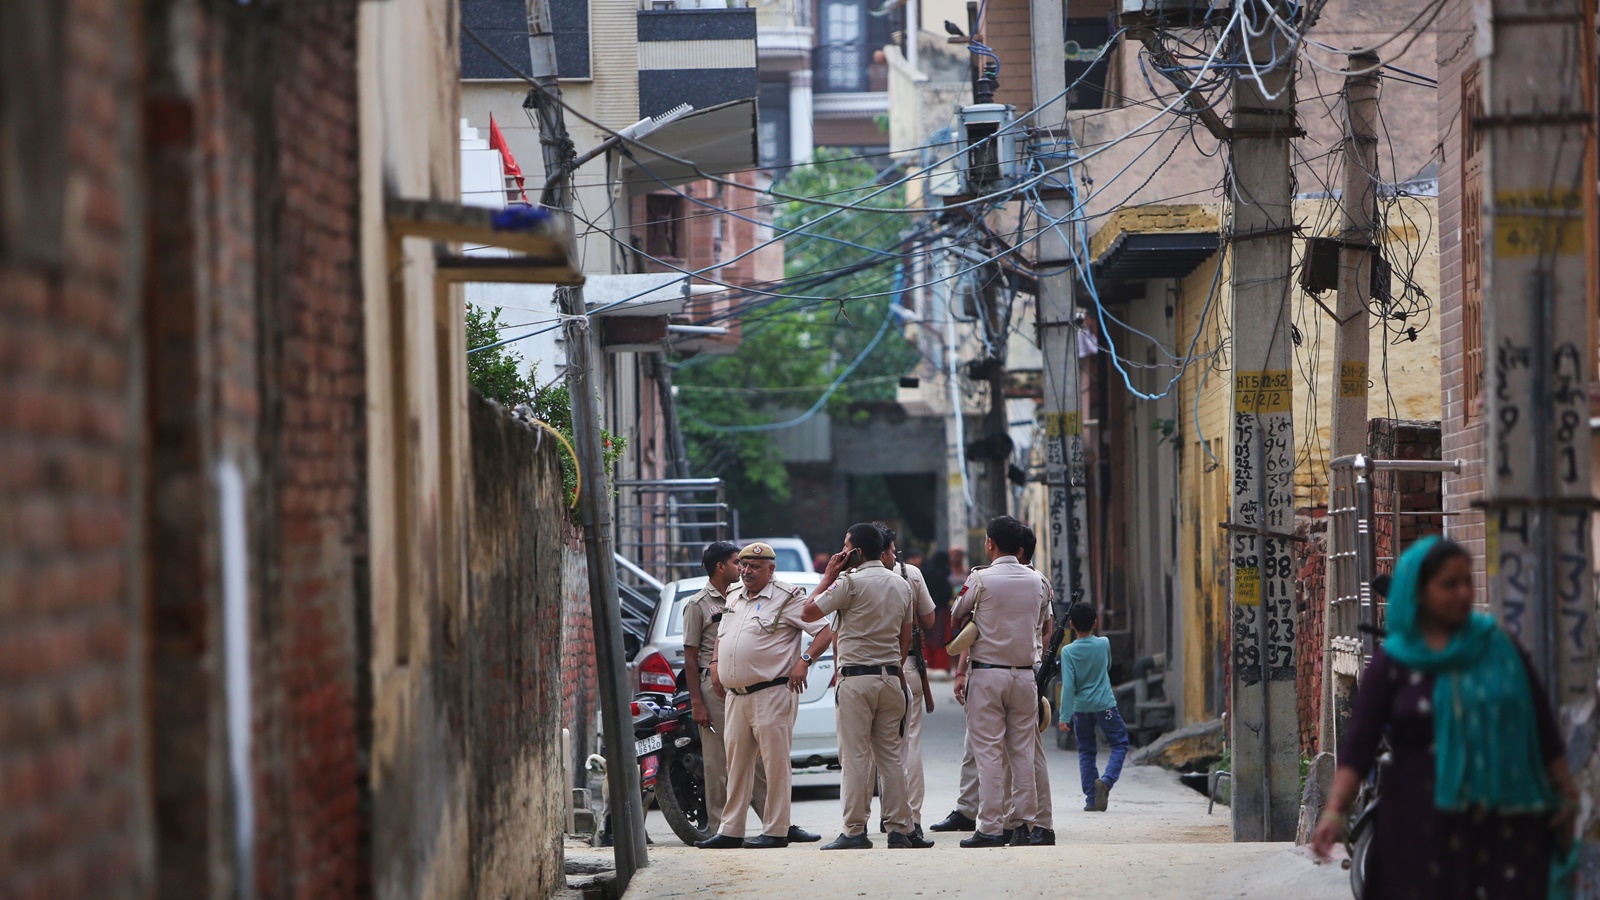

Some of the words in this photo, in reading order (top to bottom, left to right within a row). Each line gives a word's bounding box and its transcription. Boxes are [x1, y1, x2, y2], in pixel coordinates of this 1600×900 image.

[1242, 393, 1281, 410] 4/2/2
[1236, 425, 1253, 444] 75
[1235, 444, 1251, 460] 03
[1264, 438, 1287, 455] 94
[1235, 458, 1253, 469] 22
[1267, 453, 1290, 472] 66
[1235, 469, 1253, 480] 22
[1265, 555, 1292, 579] 98
[1268, 618, 1295, 643] 23
